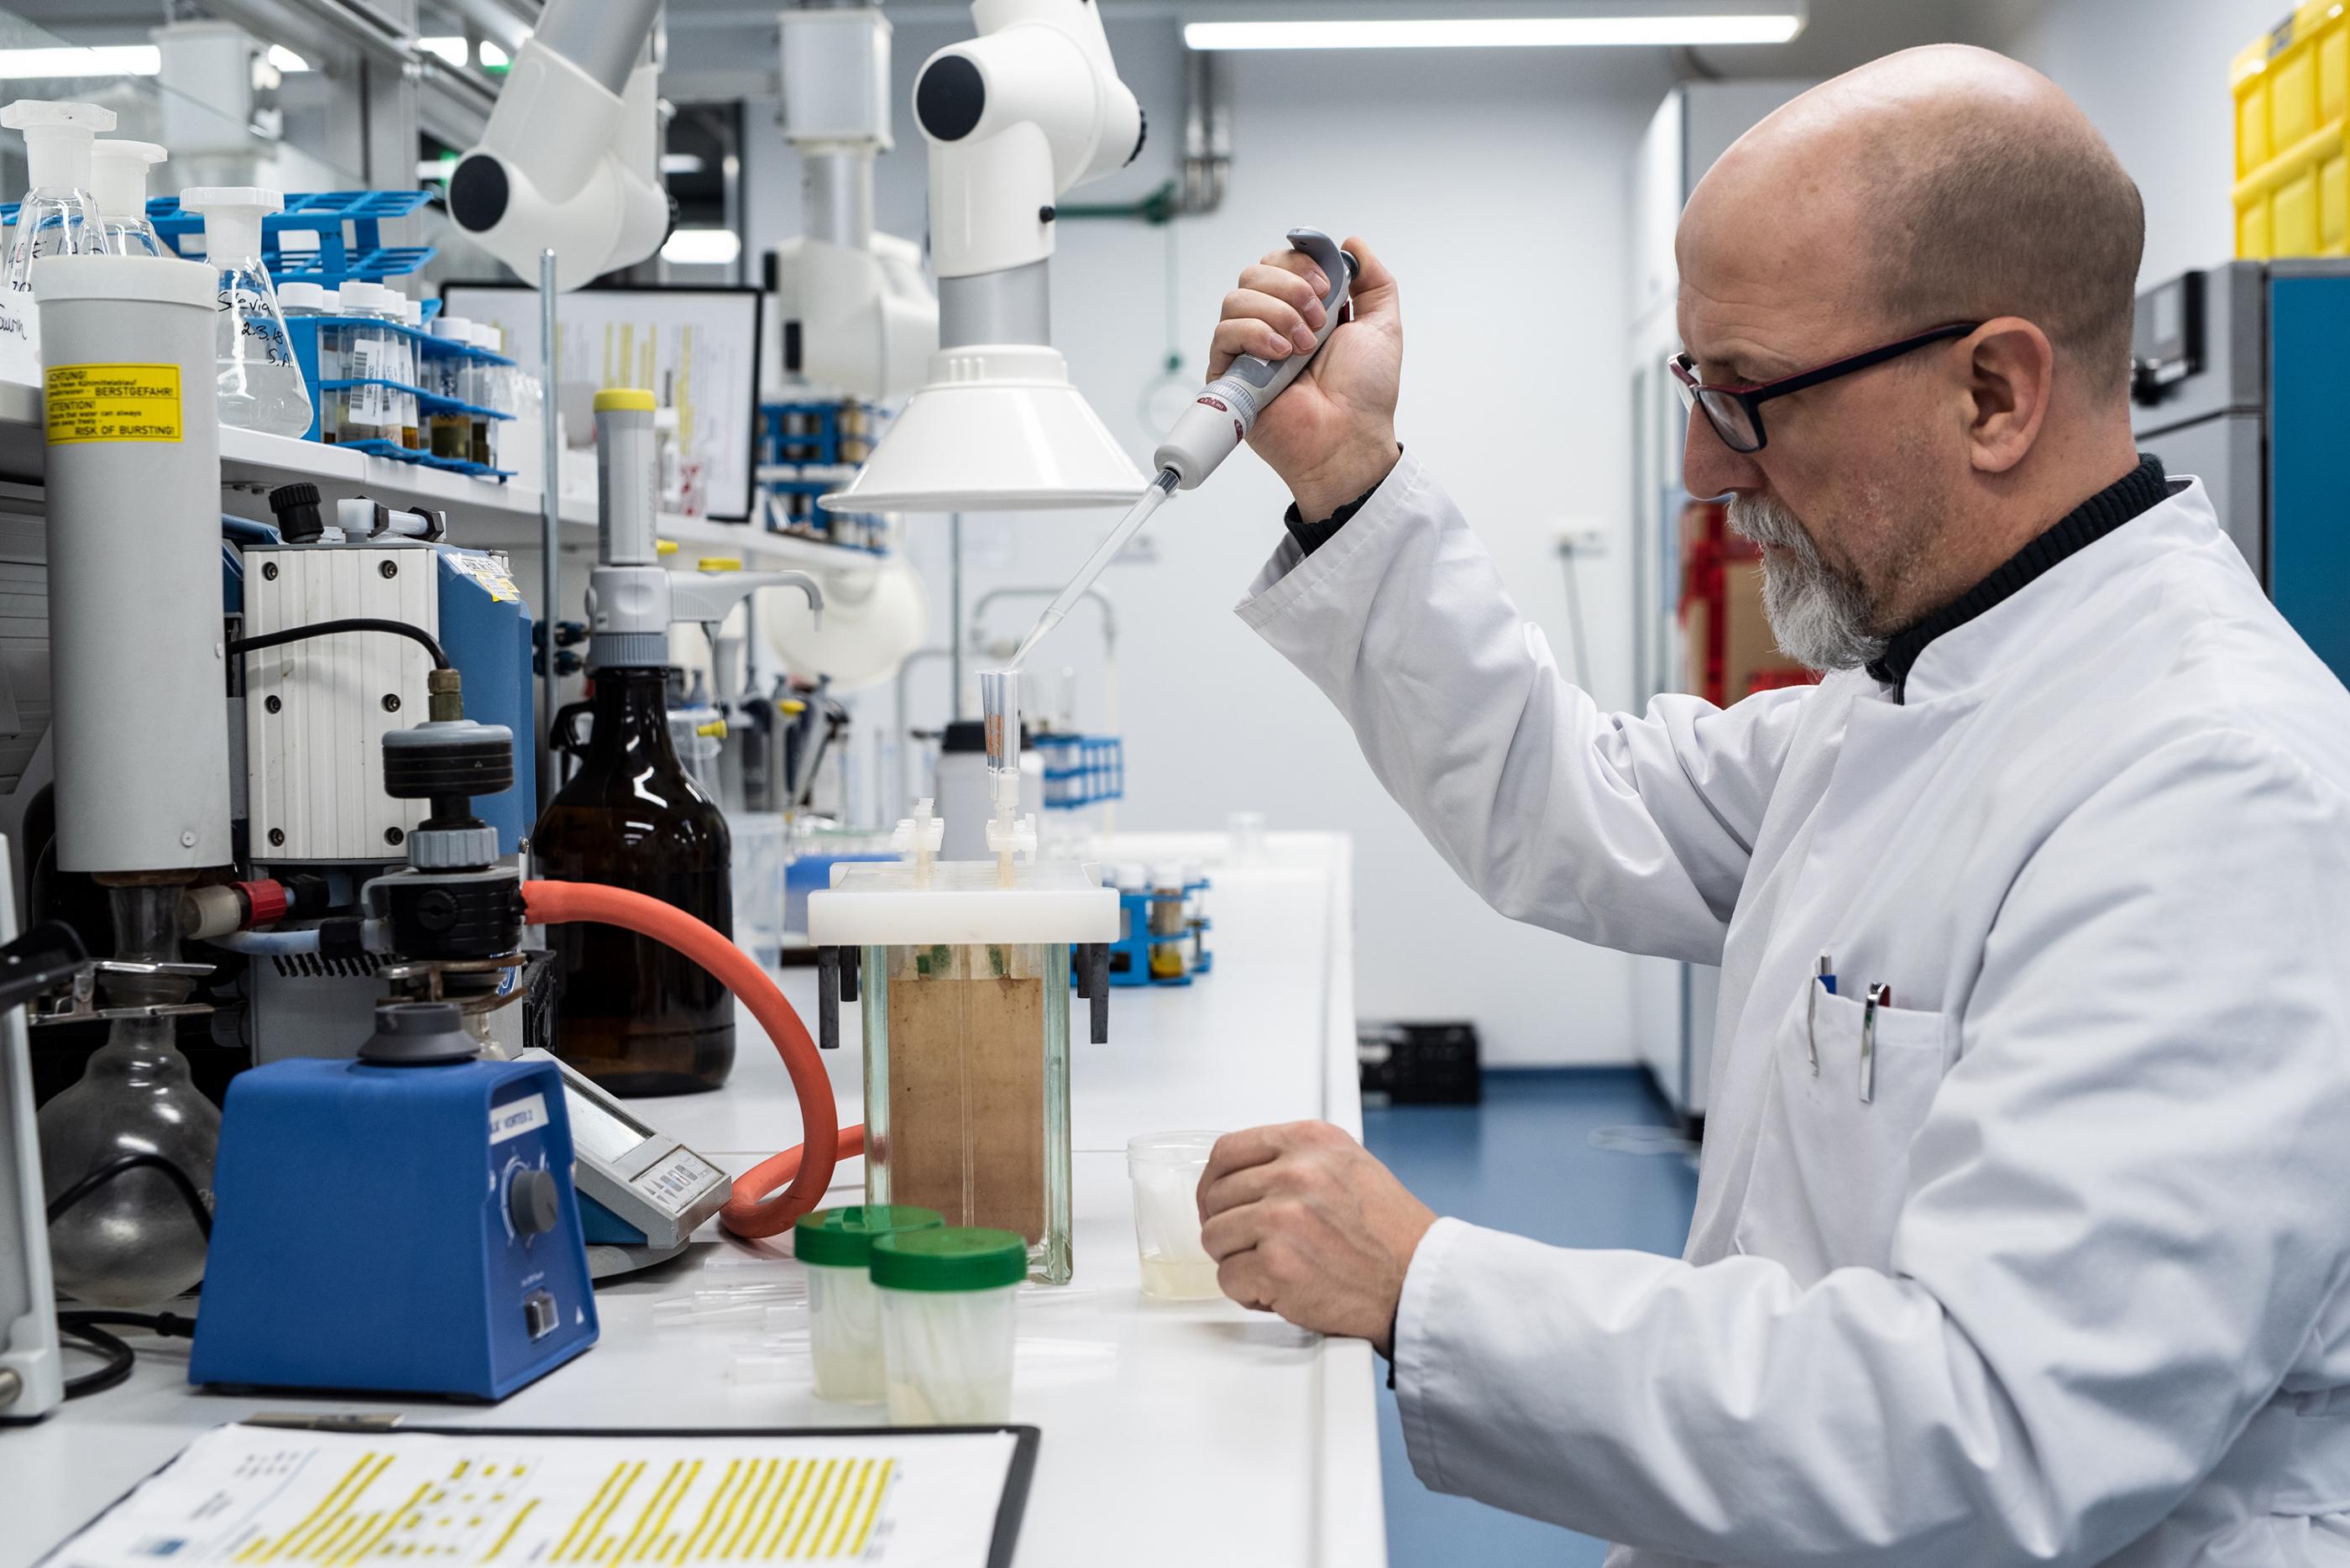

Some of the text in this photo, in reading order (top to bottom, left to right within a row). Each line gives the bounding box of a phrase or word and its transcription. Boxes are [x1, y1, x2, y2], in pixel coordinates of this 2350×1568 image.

[95, 387, 173, 397] BERSTGEFAHR!
[117, 410, 142, 418] always
[74, 426, 175, 436] RISK OF BURSTING!
